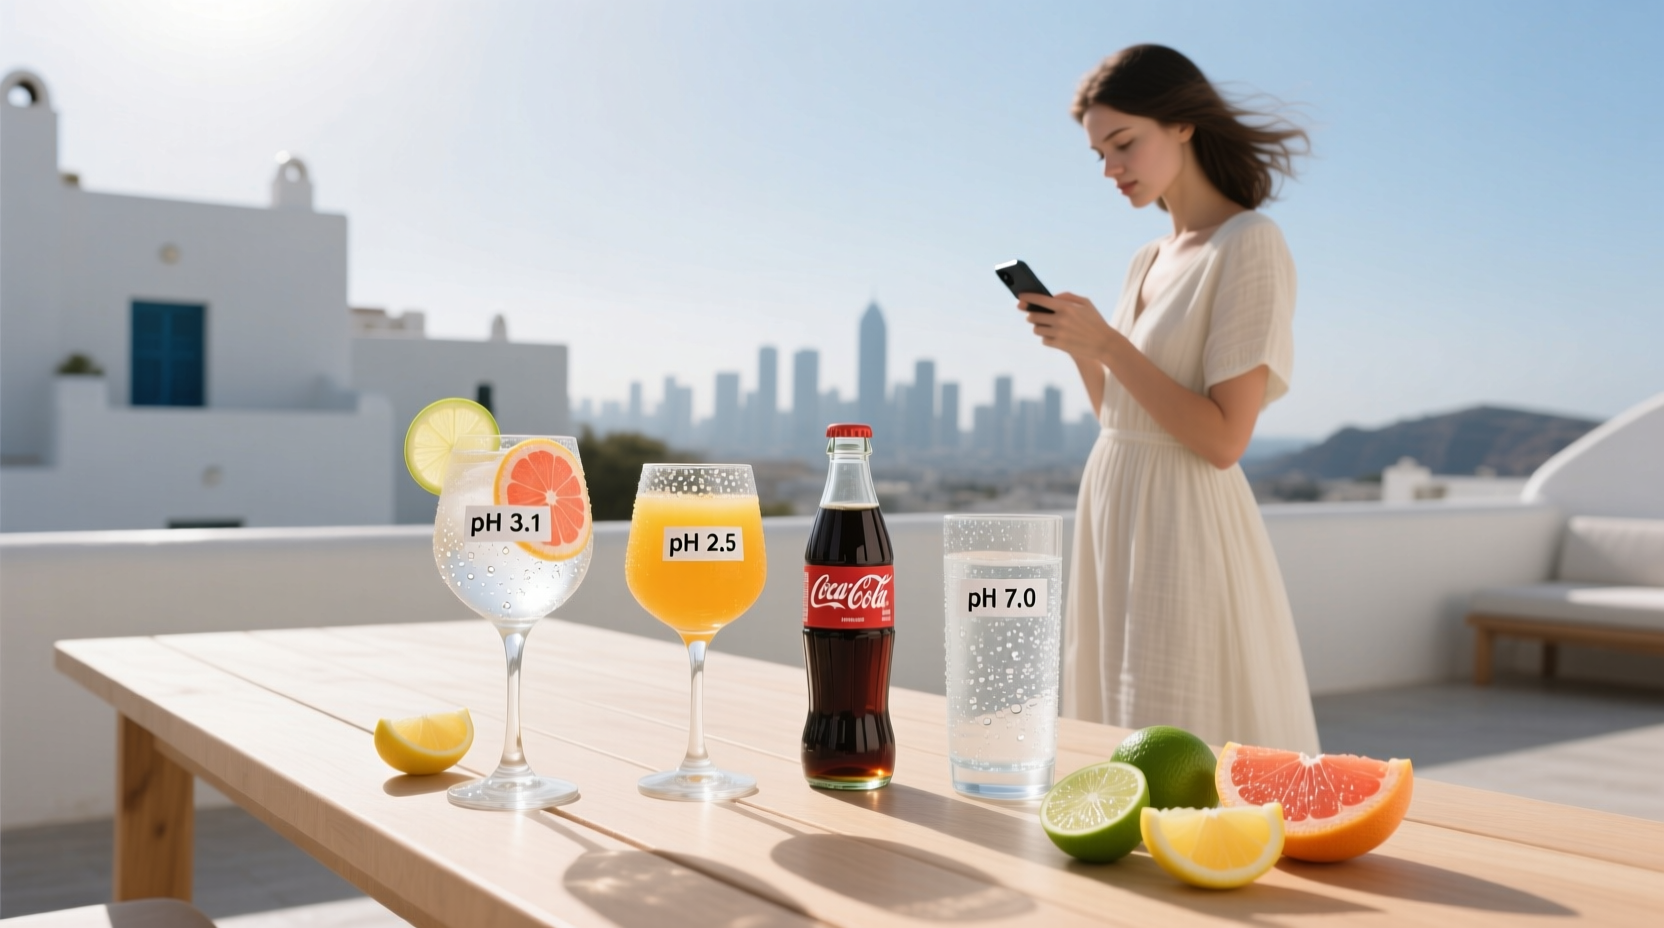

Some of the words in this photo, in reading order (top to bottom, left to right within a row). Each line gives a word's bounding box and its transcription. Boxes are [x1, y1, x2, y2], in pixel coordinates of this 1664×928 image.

[470, 512, 502, 538] pH
[509, 512, 540, 533] 3.1
[669, 532, 699, 558] pH
[706, 533, 736, 552] 2.5
[810, 574, 893, 610] Coca-Cola
[967, 587, 997, 613] pH
[1004, 587, 1036, 609] 7.0
